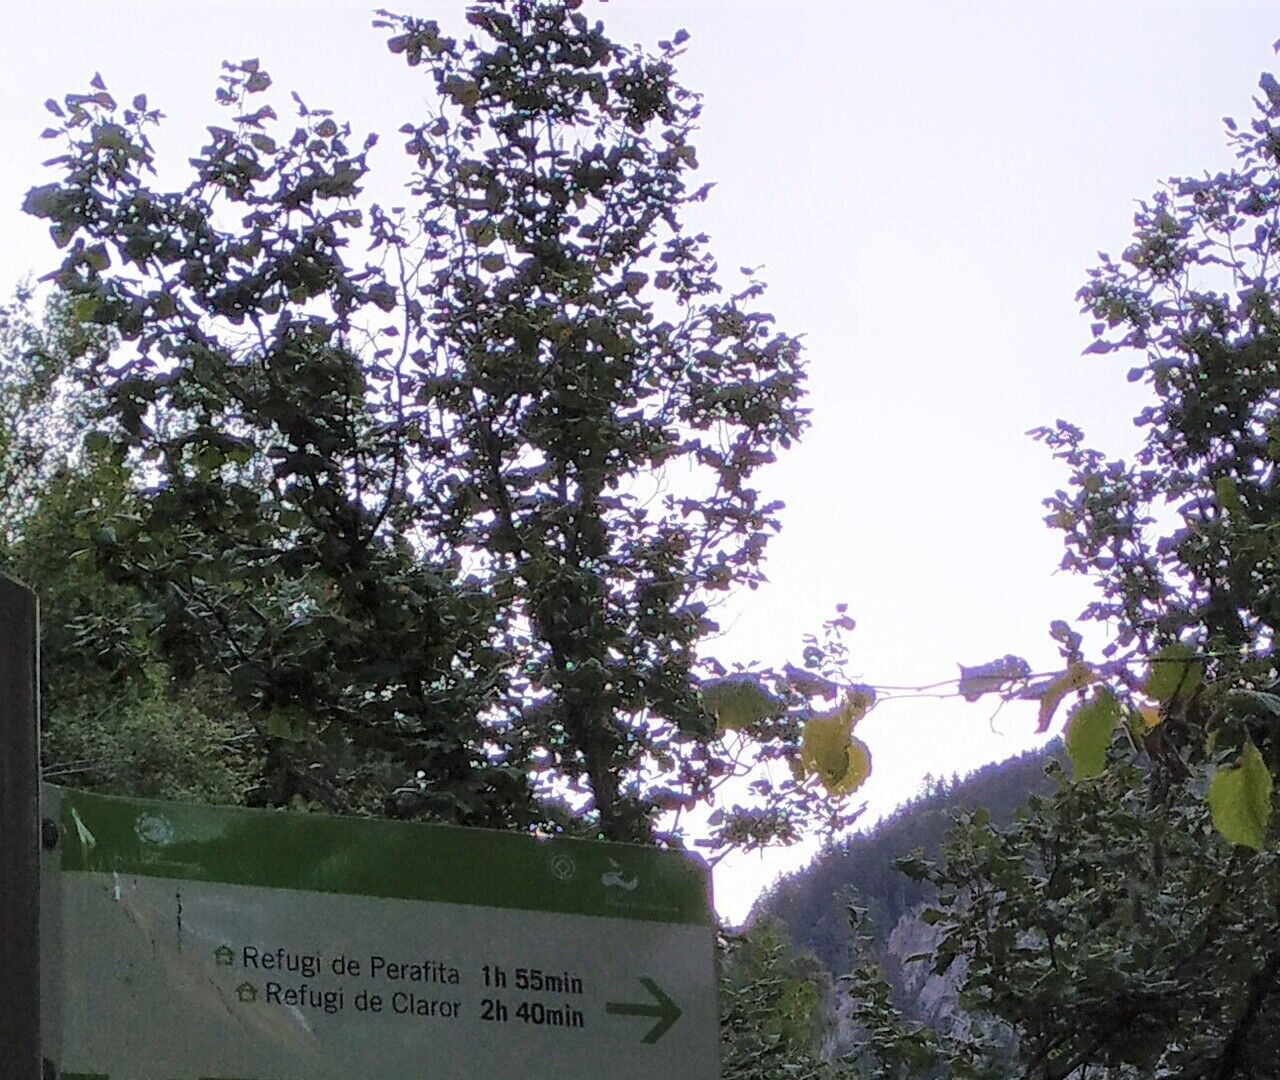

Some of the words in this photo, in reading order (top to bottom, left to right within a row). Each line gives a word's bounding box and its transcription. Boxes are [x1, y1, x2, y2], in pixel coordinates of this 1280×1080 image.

[243, 946, 321, 978] Refugi
[331, 954, 361, 976] de
[370, 956, 460, 985] Perafita
[482, 965, 507, 988] 1h
[515, 968, 583, 994] 55min
[266, 982, 344, 1014] Refugi
[354, 990, 383, 1012] de
[391, 992, 462, 1018] Claror
[480, 999, 508, 1022] 2h
[515, 1002, 584, 1028] 40min
